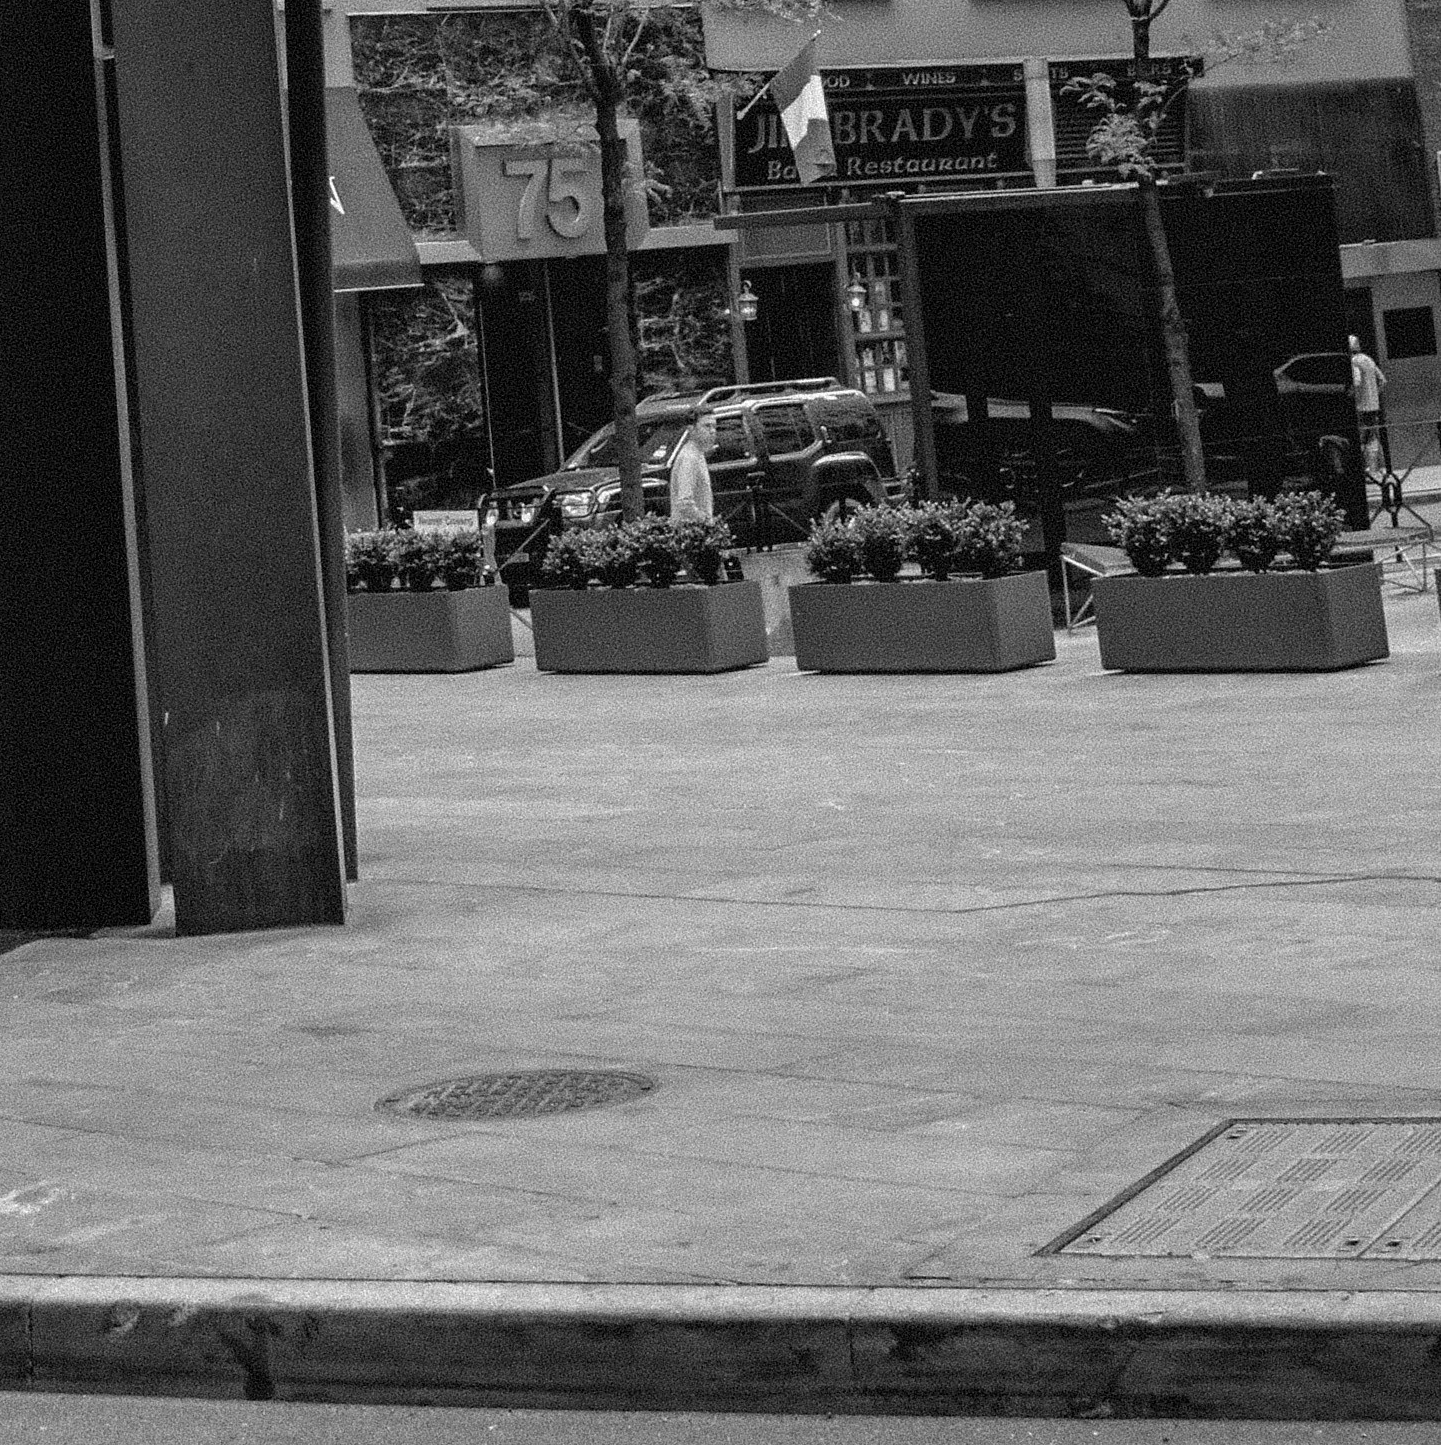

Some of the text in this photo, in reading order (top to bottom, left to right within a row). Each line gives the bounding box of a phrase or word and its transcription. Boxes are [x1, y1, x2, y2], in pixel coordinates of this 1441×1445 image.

[902, 72, 956, 86] WINES
[834, 103, 1017, 145] BRADY'S
[767, 152, 998, 180] Ba Restaurant
[502, 157, 592, 241] 75
